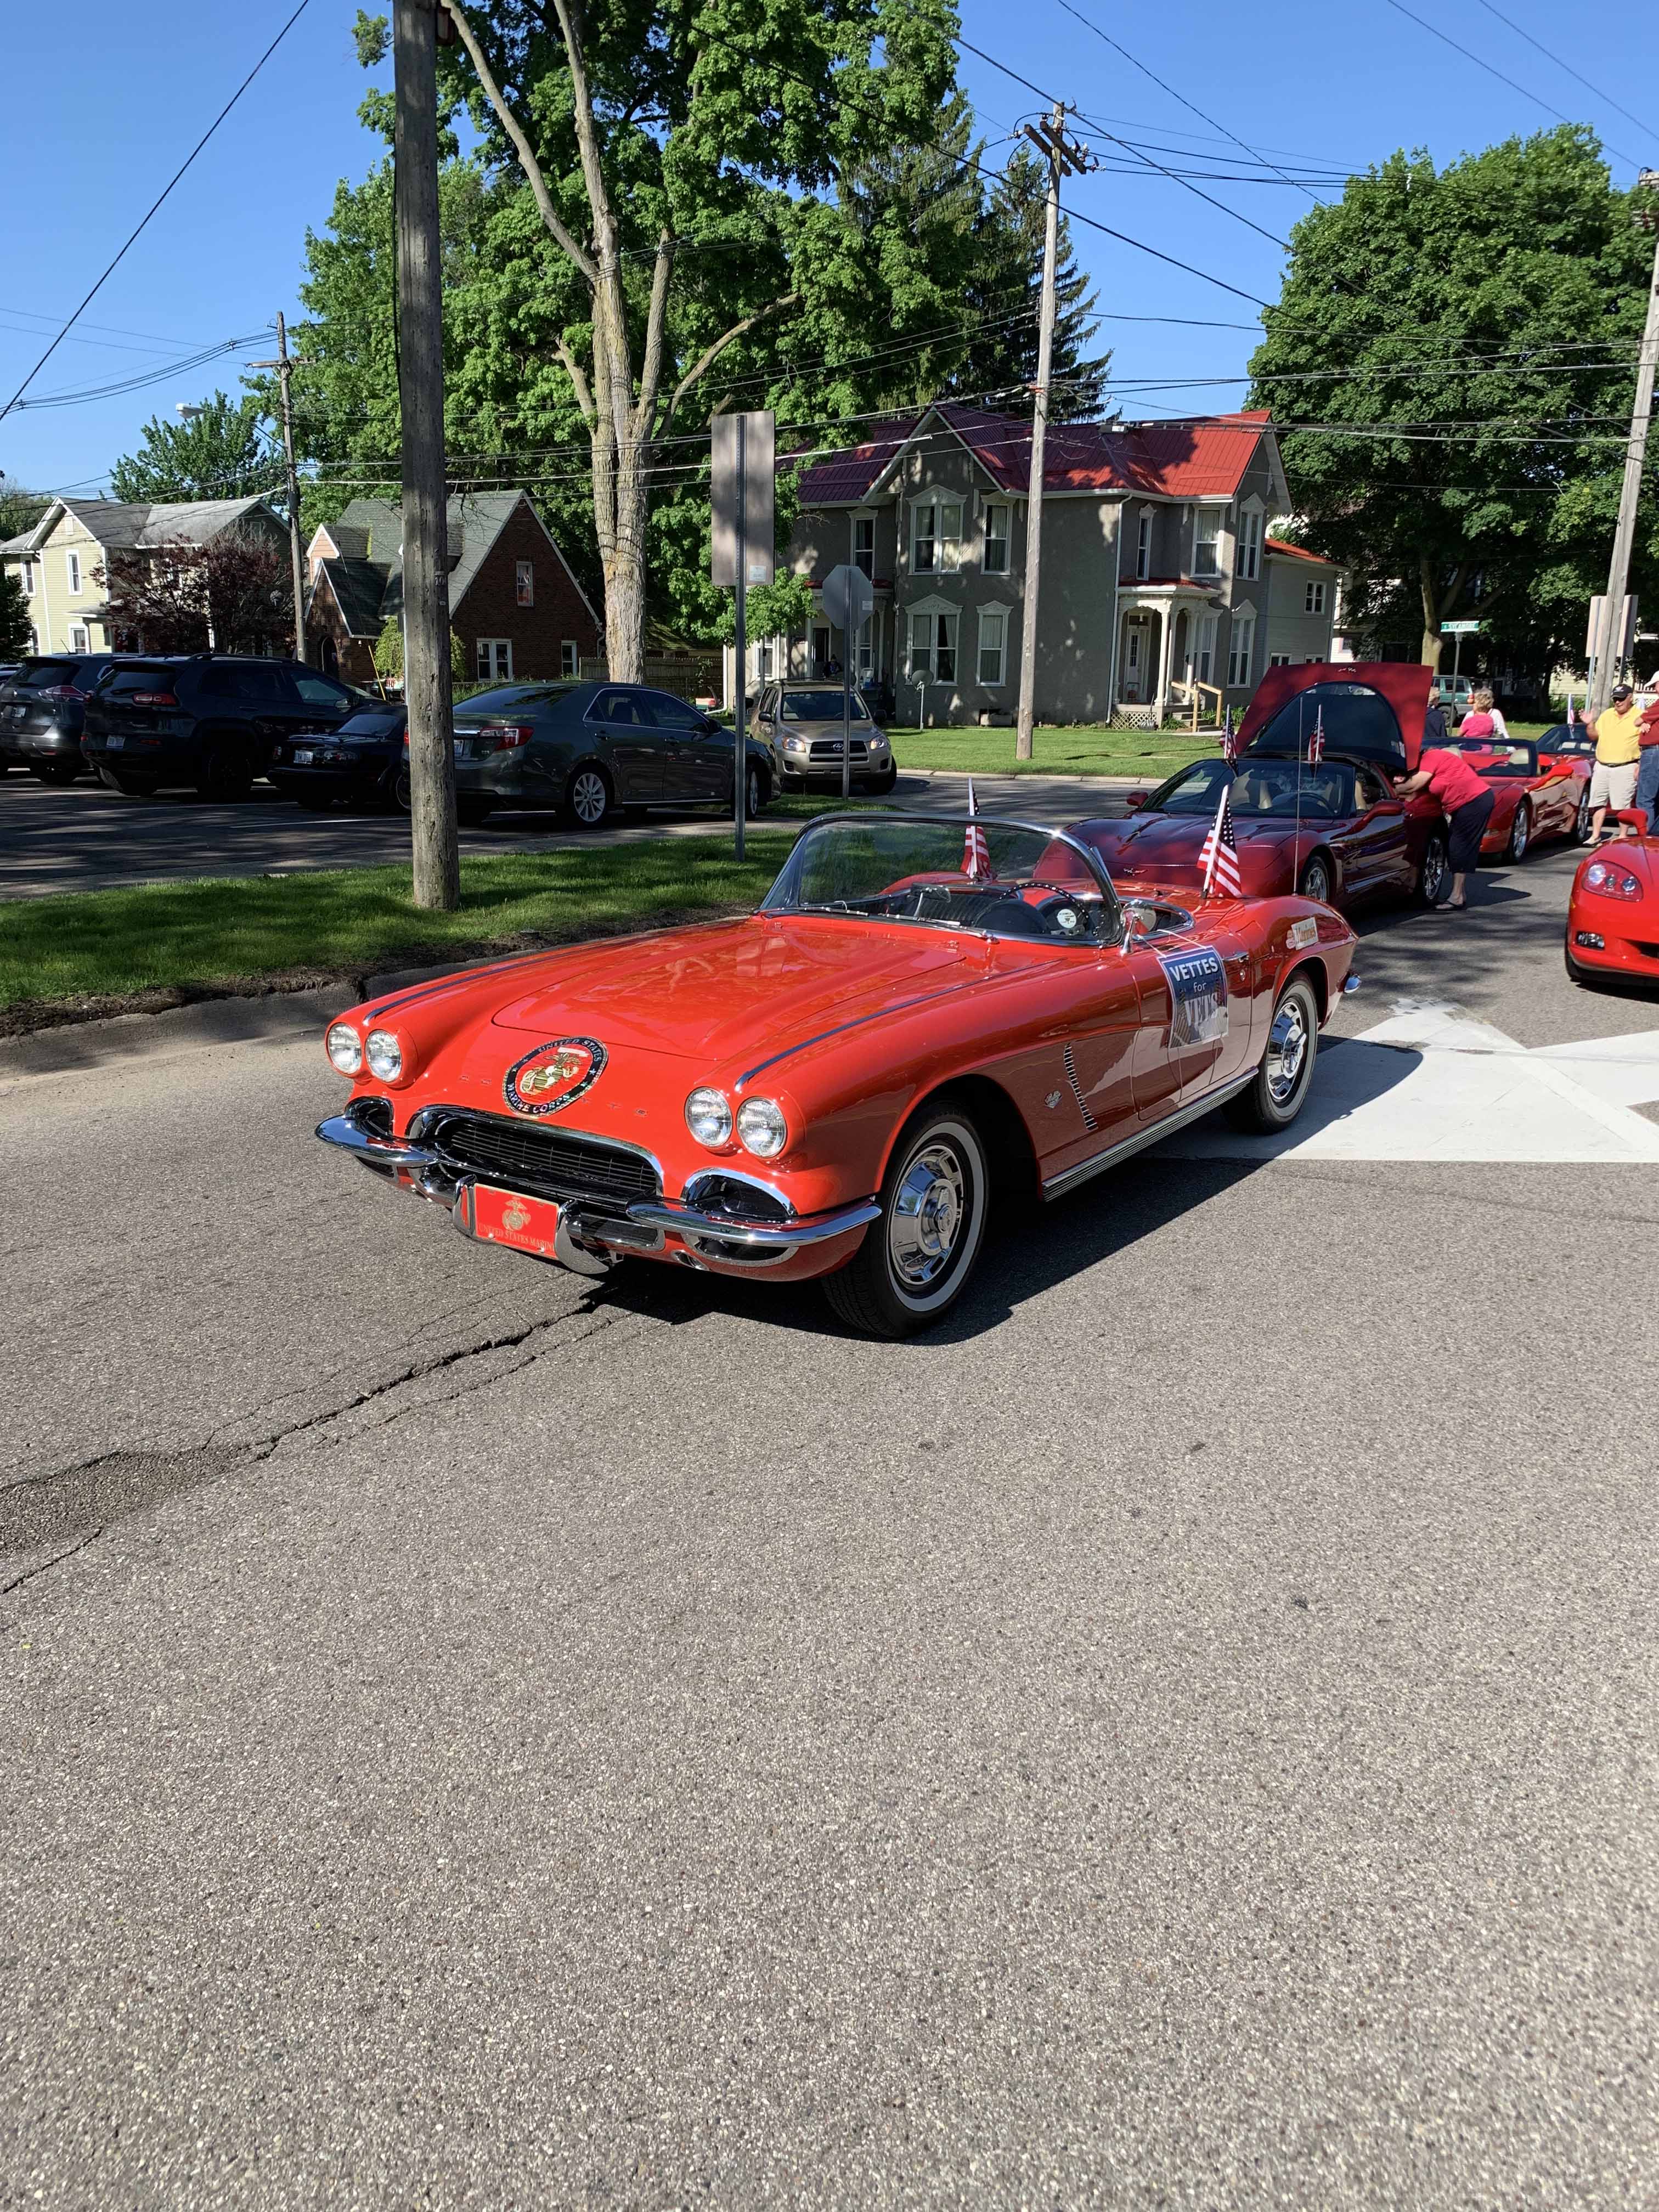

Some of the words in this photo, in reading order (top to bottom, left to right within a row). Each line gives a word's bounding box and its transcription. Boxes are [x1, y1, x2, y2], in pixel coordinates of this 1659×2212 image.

[1169, 957, 1218, 981] VETTES
[1193, 982, 1207, 992] for
[538, 1039, 580, 1053] UNITED
[583, 1040, 602, 1062] STATES
[507, 1083, 530, 1112] MARINE
[532, 1093, 571, 1113] CORPS
[478, 1223, 504, 1237] UNITED
[505, 1231, 528, 1244] STATES
